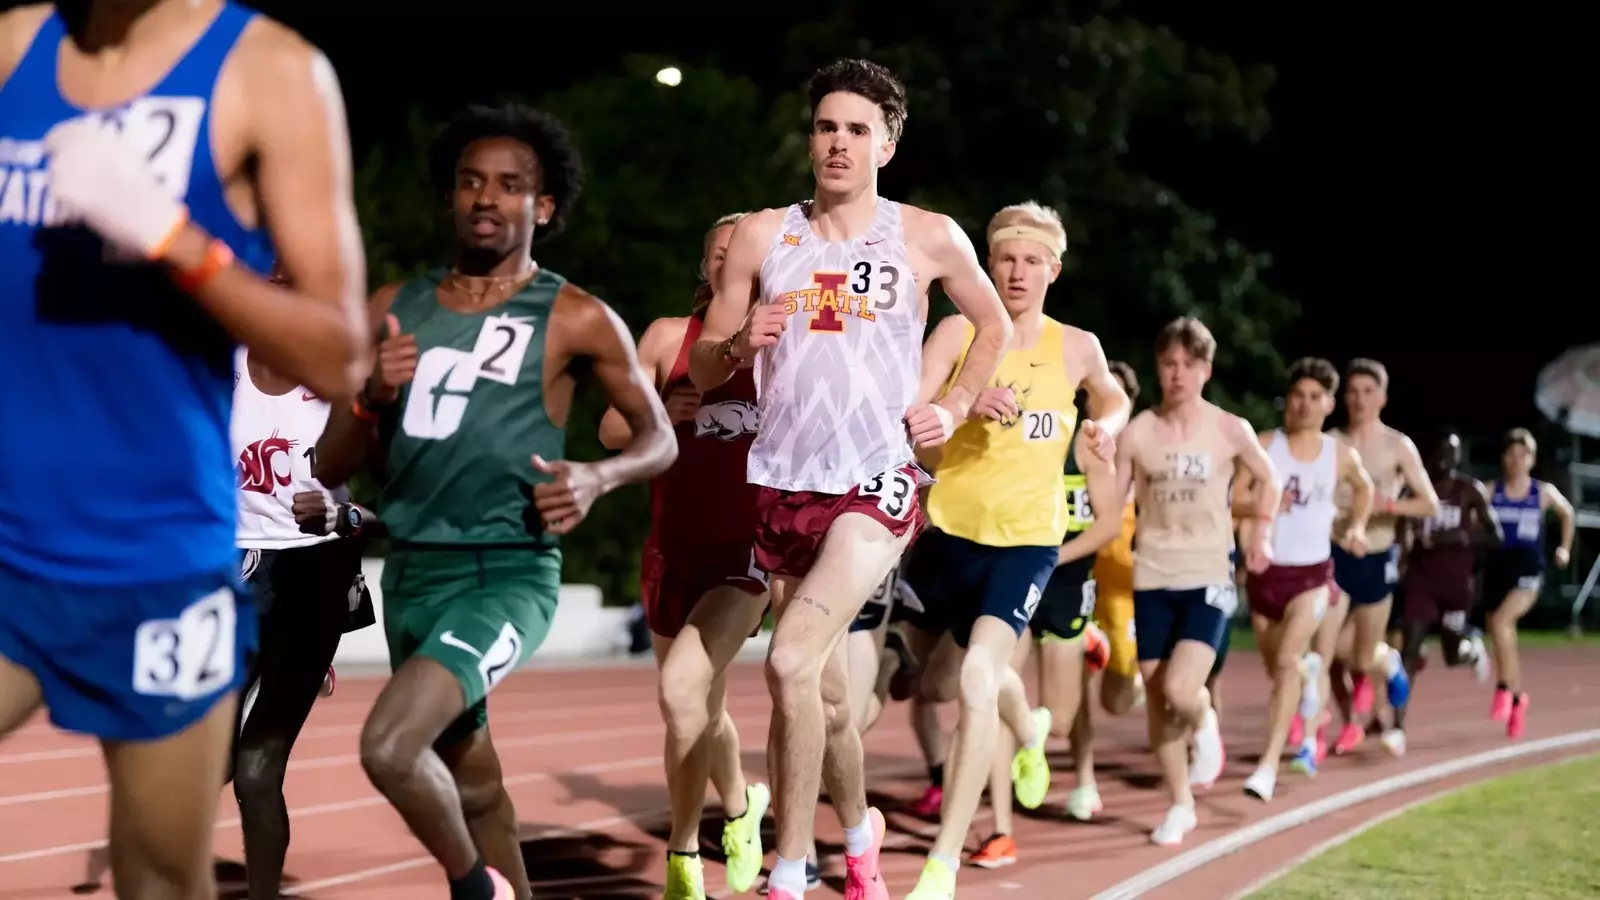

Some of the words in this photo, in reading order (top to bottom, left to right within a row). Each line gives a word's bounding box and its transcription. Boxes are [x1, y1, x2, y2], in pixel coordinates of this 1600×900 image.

[852, 261, 900, 310] 33
[480, 326, 517, 376] 2
[1028, 412, 1053, 439] 20
[864, 471, 909, 517] 33
[147, 608, 223, 684] 32
